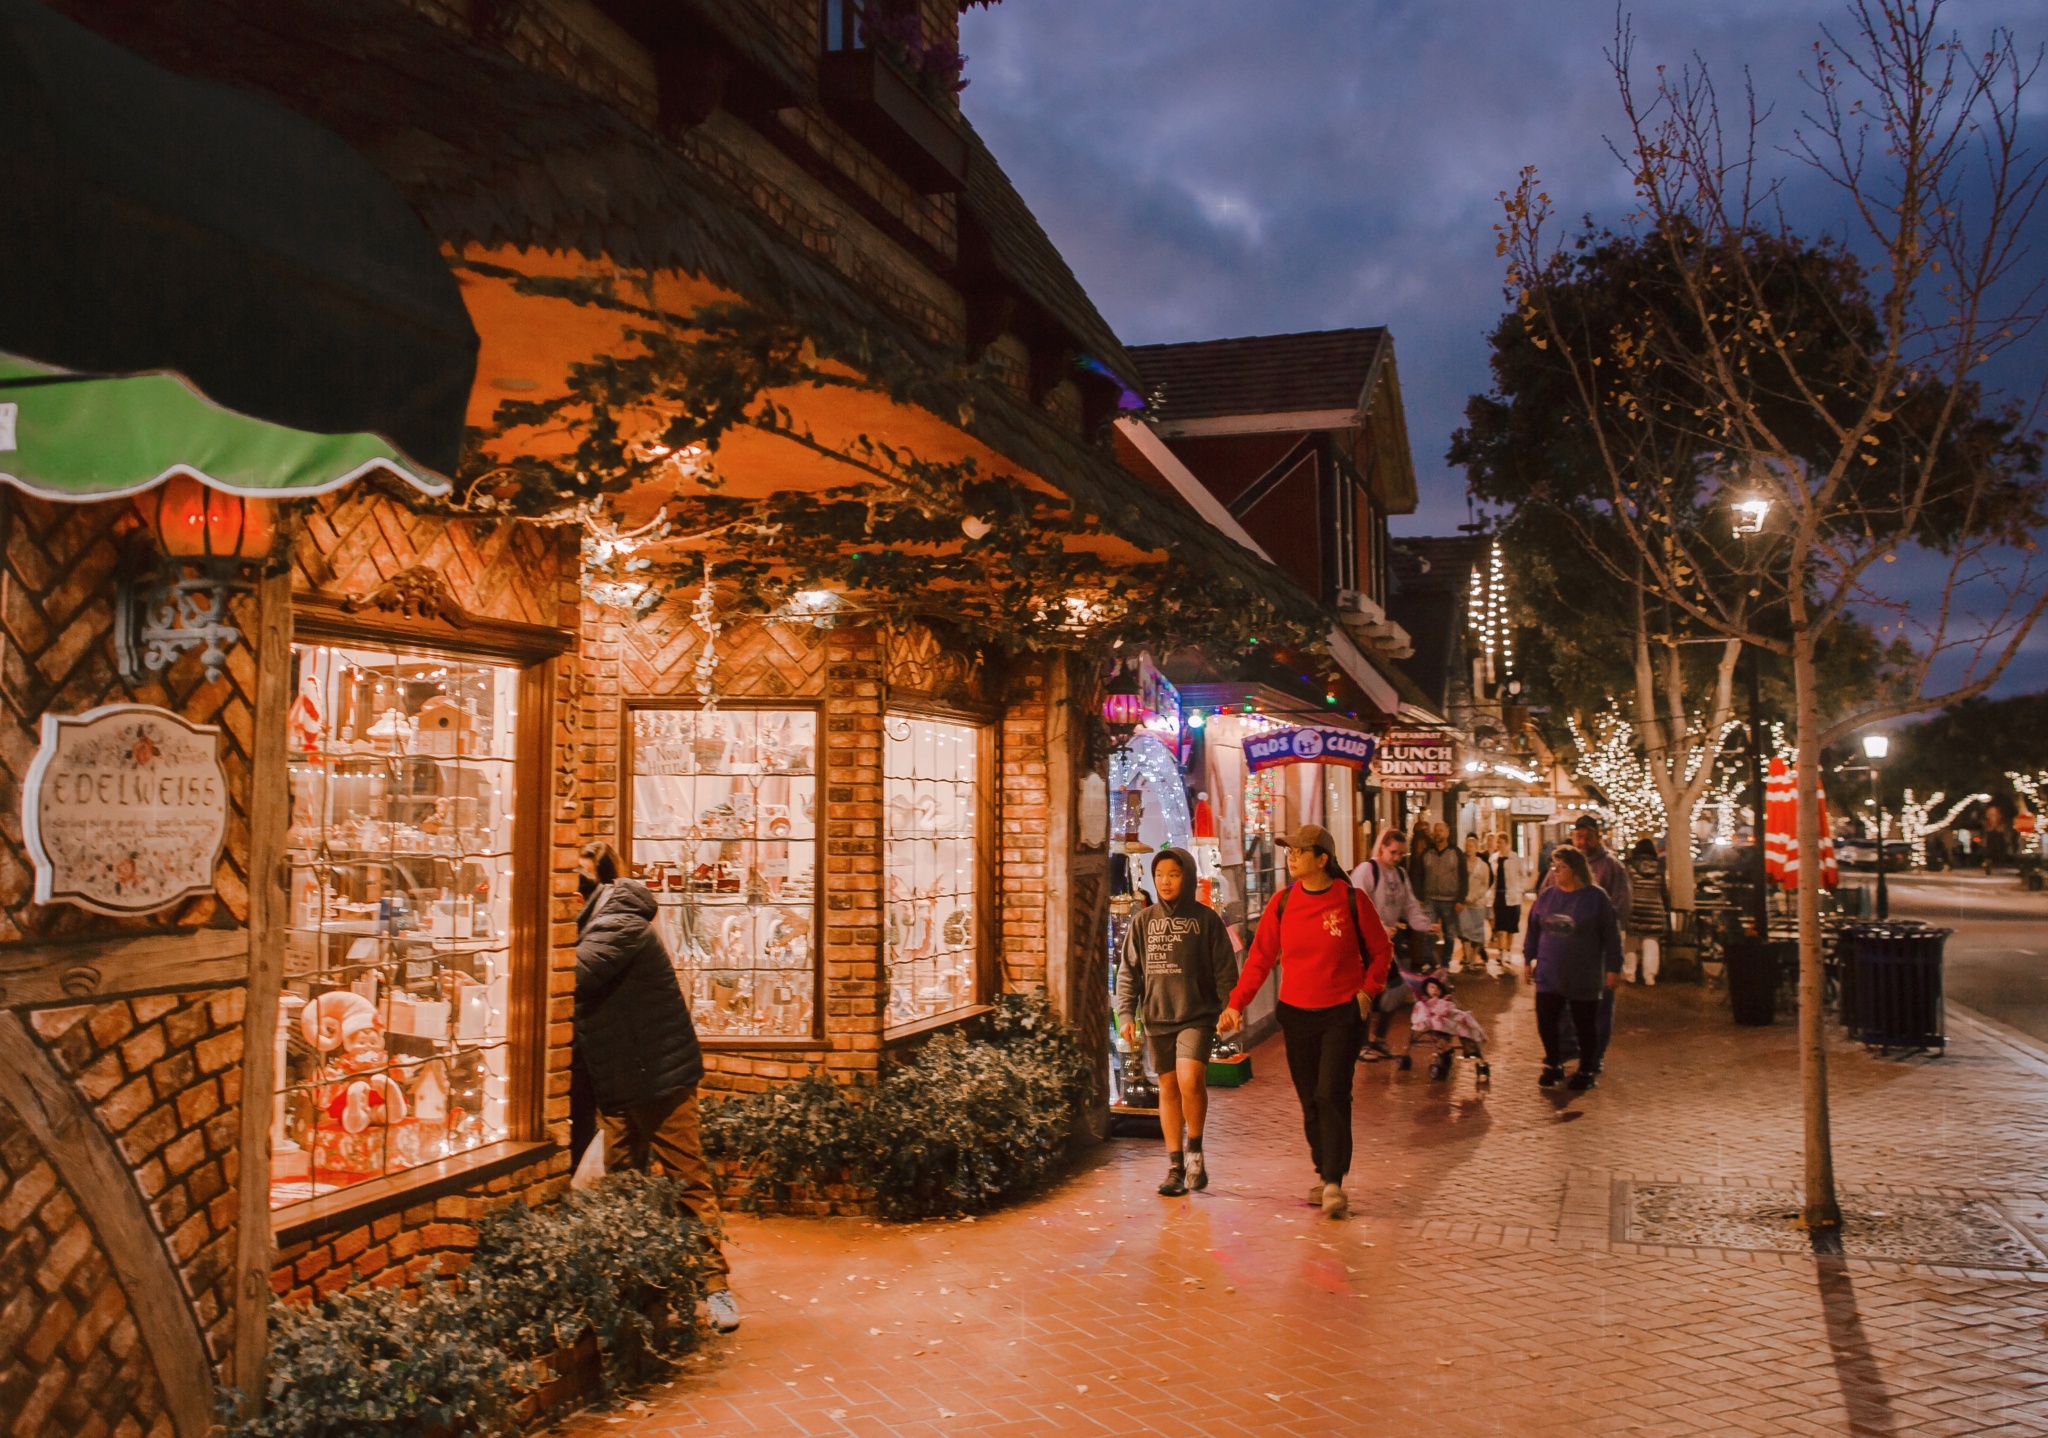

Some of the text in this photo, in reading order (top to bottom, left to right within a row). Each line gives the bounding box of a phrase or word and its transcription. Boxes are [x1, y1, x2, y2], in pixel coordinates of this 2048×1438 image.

[1249, 736, 1368, 758] KIDS CLUB
[1381, 746, 1453, 760] LUNCH
[1381, 760, 1454, 775] DINNER
[54, 772, 216, 806] EDELWEISS
[1386, 781, 1445, 790] COCKTAILS
[1147, 917, 1200, 935] NASA
[1147, 934, 1183, 944] CRITICAL
[1147, 943, 1174, 952] SPACE
[1147, 952, 1167, 961] ITEM
